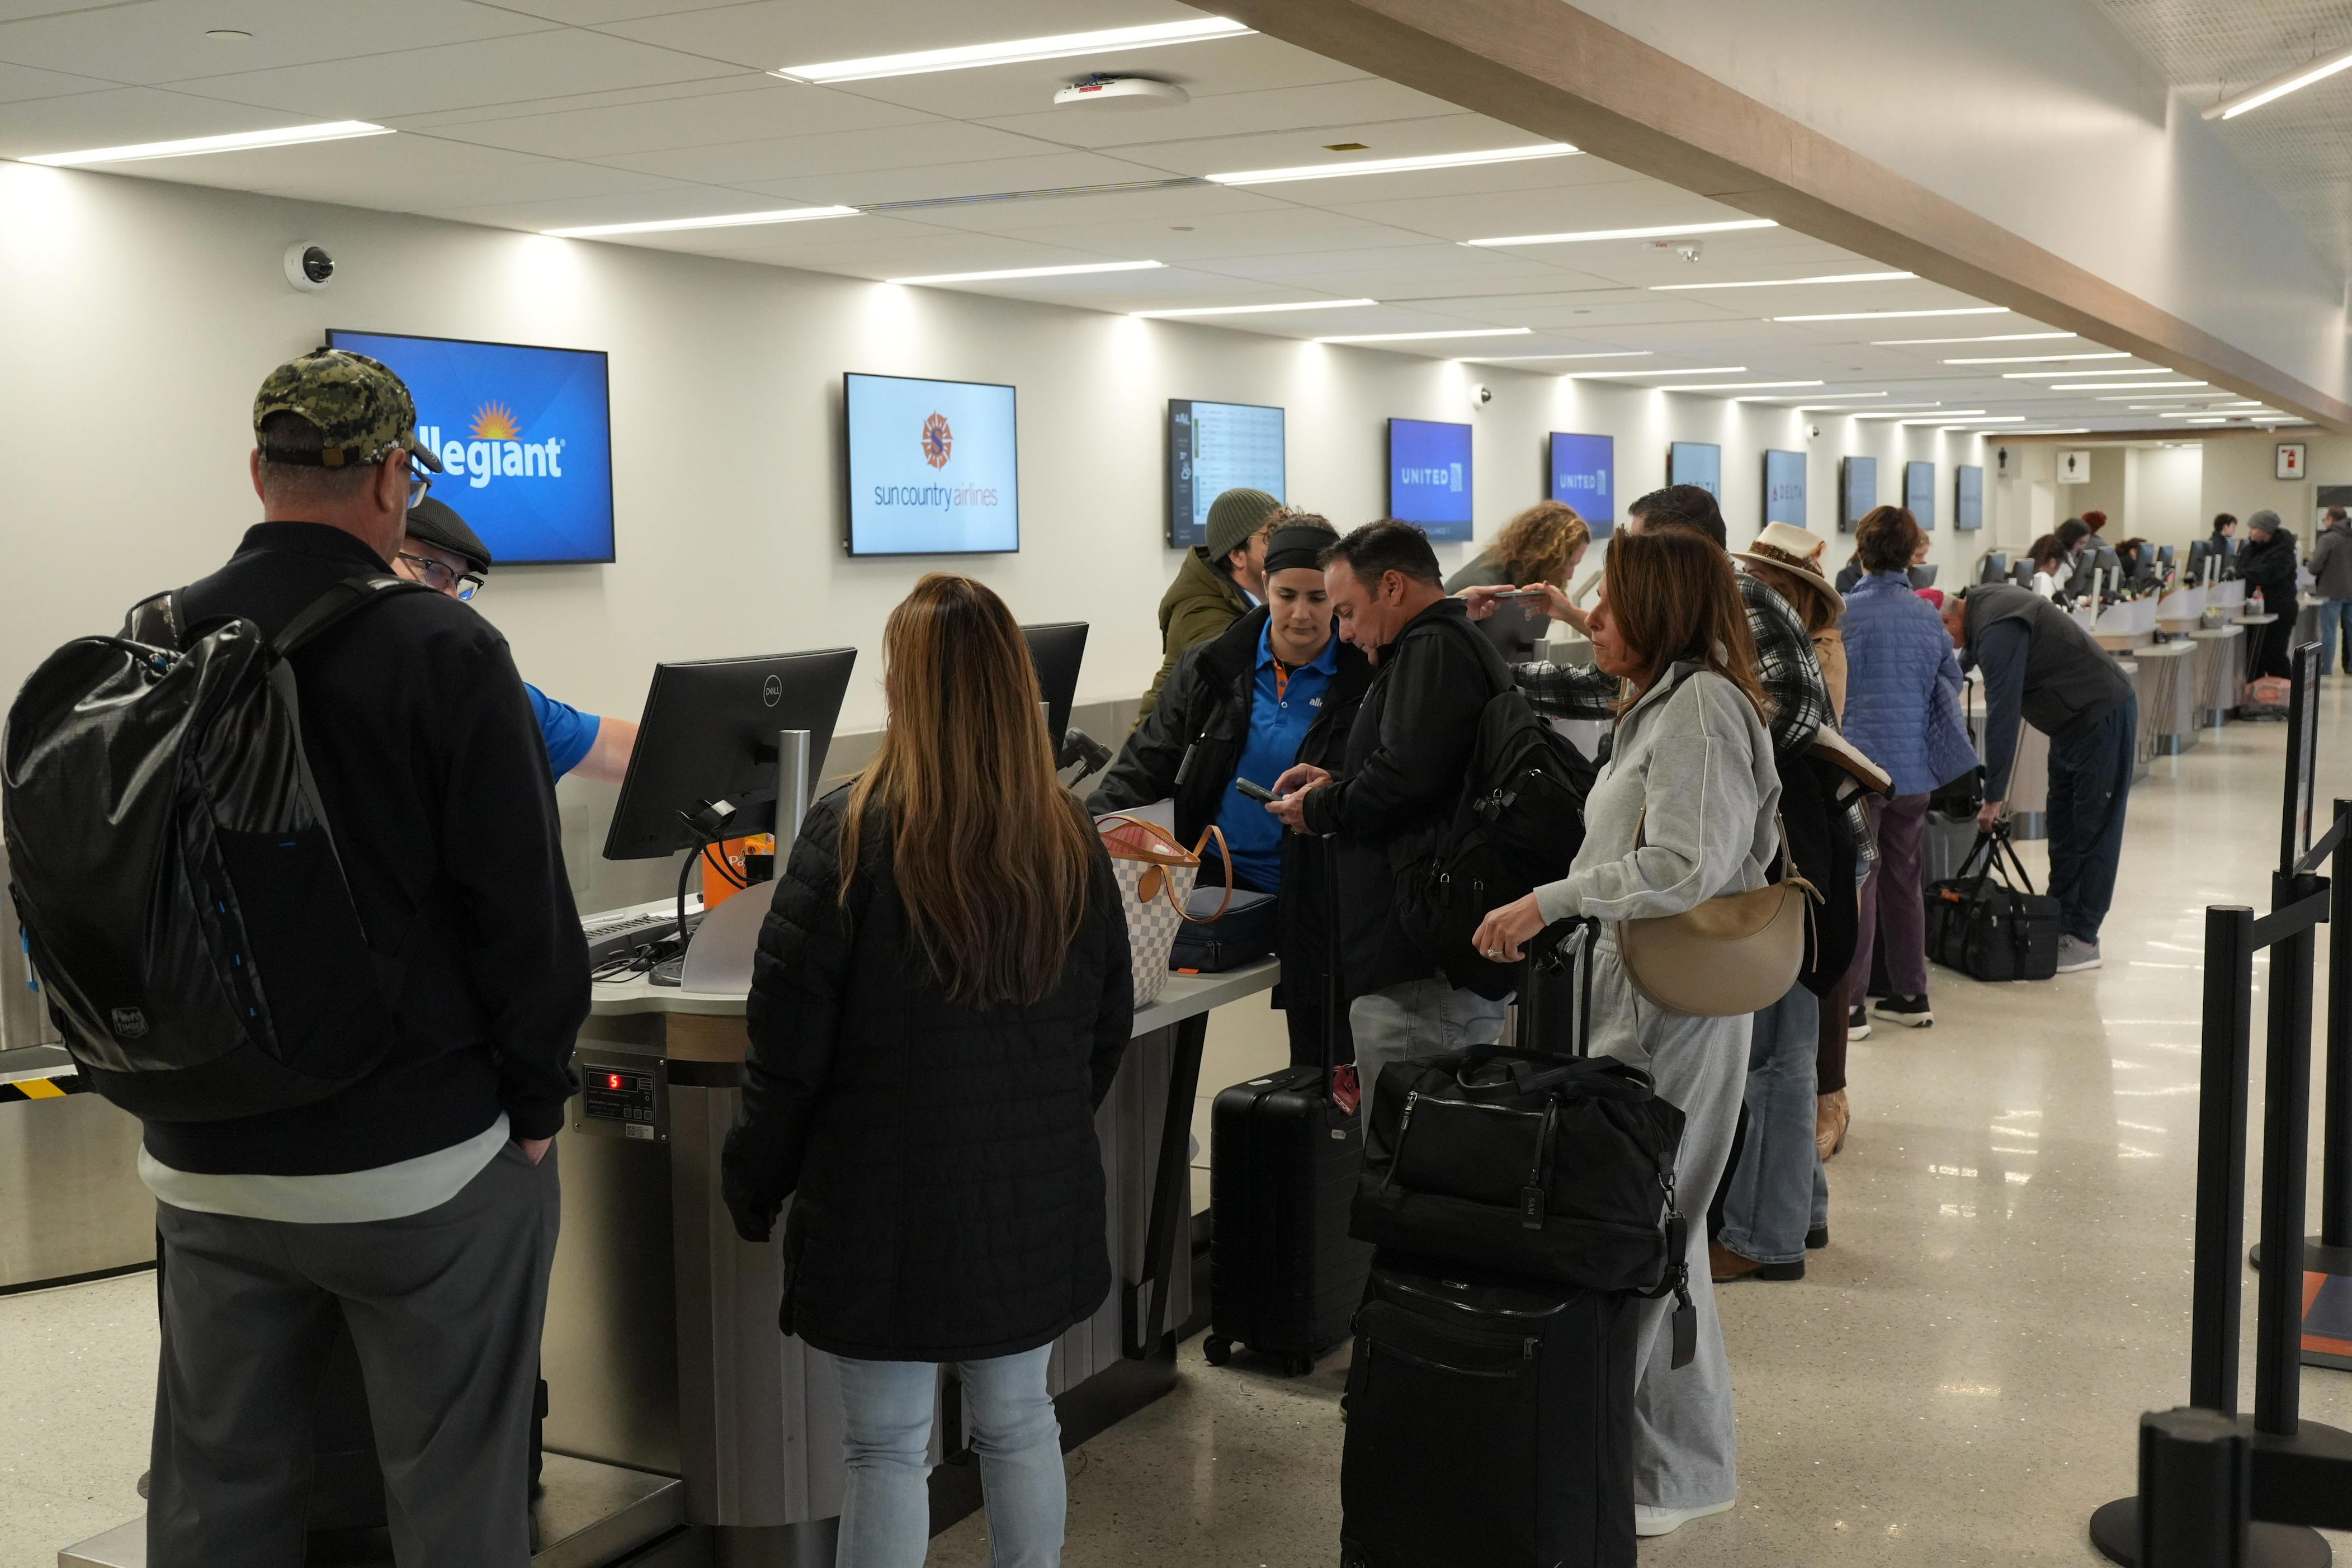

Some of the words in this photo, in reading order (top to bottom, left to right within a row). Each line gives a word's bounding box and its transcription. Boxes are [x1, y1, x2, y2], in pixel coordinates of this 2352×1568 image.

[411, 426, 561, 488] llegiant
[1401, 467, 1448, 485] UNITED
[1559, 474, 1596, 489] UNITED
[875, 485, 900, 506] sun
[901, 482, 952, 511] country
[954, 483, 998, 506] airlines
[1780, 484, 1802, 500] DELTA
[766, 687, 780, 696] DELL
[611, 1076, 617, 1087] 5
